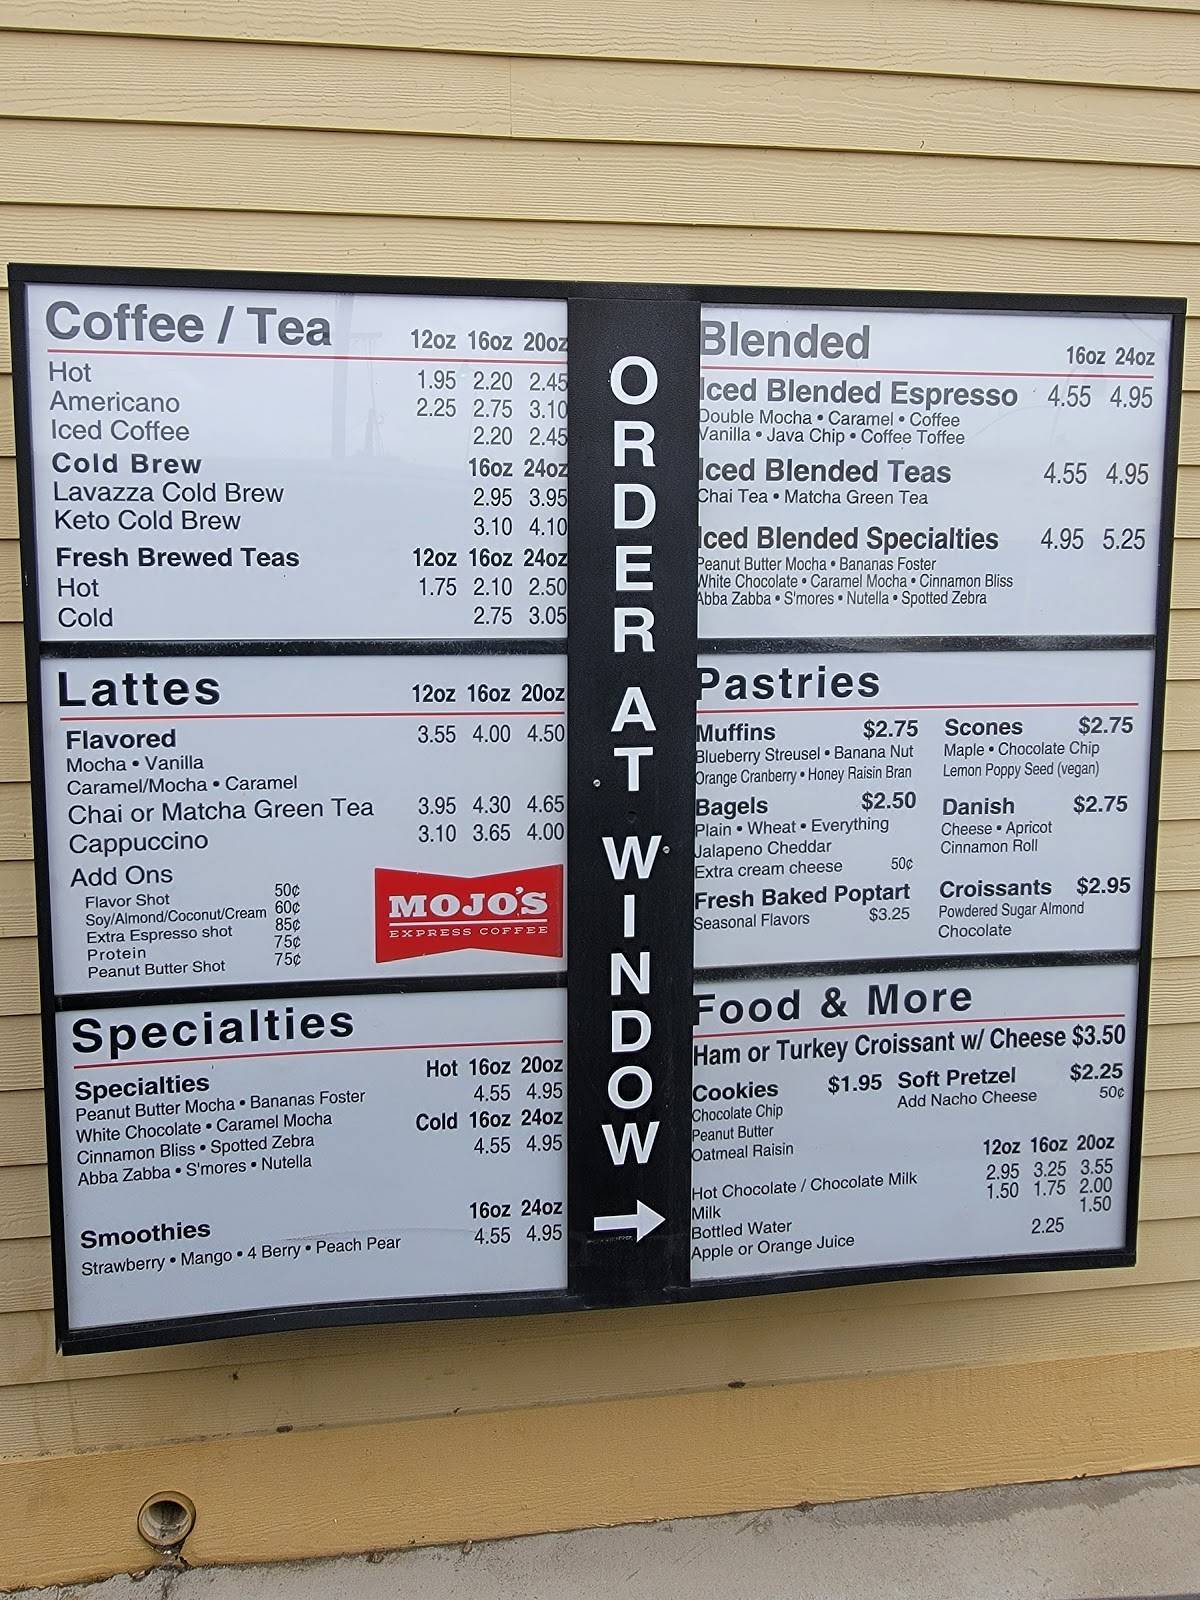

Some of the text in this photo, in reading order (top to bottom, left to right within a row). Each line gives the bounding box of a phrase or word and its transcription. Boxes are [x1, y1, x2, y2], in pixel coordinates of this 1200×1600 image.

[46, 301, 331, 346] Coffee Tea
[411, 329, 512, 350] 12oz 16oz
[701, 321, 869, 359] Blended
[1115, 347, 1155, 365] 24oz
[50, 361, 91, 382] Hot
[418, 370, 512, 390] 1.95 2.20
[50, 391, 179, 412] Americano
[891, 381, 1017, 410] Espresso
[1048, 384, 1152, 408] 4.55 4.95
[417, 398, 512, 418] 2.25 2.75
[829, 411, 893, 425] Caramel
[52, 419, 189, 441] Iced Coffee
[474, 426, 512, 445] 2.20
[767, 428, 965, 446] Java Chip Toffee
[52, 453, 201, 473] Cold Brew
[469, 458, 512, 477] 16oz
[699, 458, 951, 483] Iced Blended Teas
[54, 482, 284, 502] Lavazza Cold Brew
[785, 489, 928, 504] Matcha Green Tea
[55, 510, 109, 529] Keto
[474, 517, 567, 536] 3.10 4.10
[867, 527, 998, 555] Specialties
[1041, 528, 1145, 549] 4.95 5.25
[57, 548, 299, 567] Fresh Brewed Teas
[745, 557, 827, 570] Butter Mocha
[58, 578, 99, 597] Hot
[420, 578, 512, 595] 1.75 2.10
[735, 574, 1013, 588] Chocolate Cinnamon Bliss
[784, 591, 986, 608] S'mores Spotted Zebra
[59, 672, 219, 706] Lattes
[697, 666, 879, 700] Pastries
[413, 684, 565, 702] 12oz 20oz
[418, 724, 564, 743] 3.55 4.00 4.50
[696, 719, 918, 742] Muffins $2.75
[945, 716, 1133, 736] Scones $2.75
[67, 729, 175, 749] Flavored
[945, 741, 1099, 759] Maple Chocolate Chip
[67, 755, 204, 772] Mocha Vanilla
[602, 356, 662, 1165] ORDER AT WINDOW
[986, 761, 1099, 779] Poppy (vegan)
[68, 775, 297, 795] Caramel/Mocha Caramel
[741, 769, 797, 785] Cranberry
[69, 800, 323, 824] Chai Matcha Green
[419, 795, 564, 814] 3.95 4.65
[696, 791, 916, 819] Bagels $2.50
[943, 798, 1014, 815] Danish
[748, 817, 888, 834] Wheat Everything
[942, 823, 992, 835] Cheese
[70, 831, 208, 857] Cappuccino
[768, 840, 832, 854] Cheddar
[71, 867, 116, 887] Add
[790, 861, 842, 874] cheese
[762, 884, 910, 906] Baked Poptart
[940, 877, 1130, 898] Croissants $2.95
[86, 894, 169, 908] Flavor Shot
[389, 887, 547, 917] MOJO'S
[939, 902, 1084, 918] Powdered Almond
[86, 908, 266, 928] Soy/Almond/Coconut/Cream
[762, 907, 909, 926] Flavors $3.25
[87, 929, 197, 943] Extra Espresso
[389, 927, 547, 937] EXPRESS COFFEE
[89, 961, 225, 978] Peanut Butter Shot
[693, 984, 971, 1026] Food More
[73, 1007, 354, 1060] Specialties
[694, 1024, 1125, 1066] Ham Turkey Croissant Cheese $3.50
[898, 1063, 1122, 1088] Soft Pretzel $2.25
[693, 1074, 882, 1102] Cookies $1.95
[898, 1093, 977, 1108] Add Nacho
[76, 1105, 130, 1122] Peanut
[522, 1109, 563, 1126] 24oz
[76, 1128, 120, 1143] White
[474, 1137, 510, 1154] 4.55
[987, 1158, 1113, 1180] 2.95 3.25 3.55
[692, 1206, 721, 1220] Milk
[1080, 1196, 1111, 1212] 1.50
[81, 1222, 210, 1248] Smoothies
[692, 1221, 792, 1239] Bottled Water
[1032, 1217, 1064, 1234] 2.25
[82, 1237, 401, 1276] Strawberry Mango 4 Berry Peach Pear
[692, 1235, 854, 1262] Apple Orange Juice
